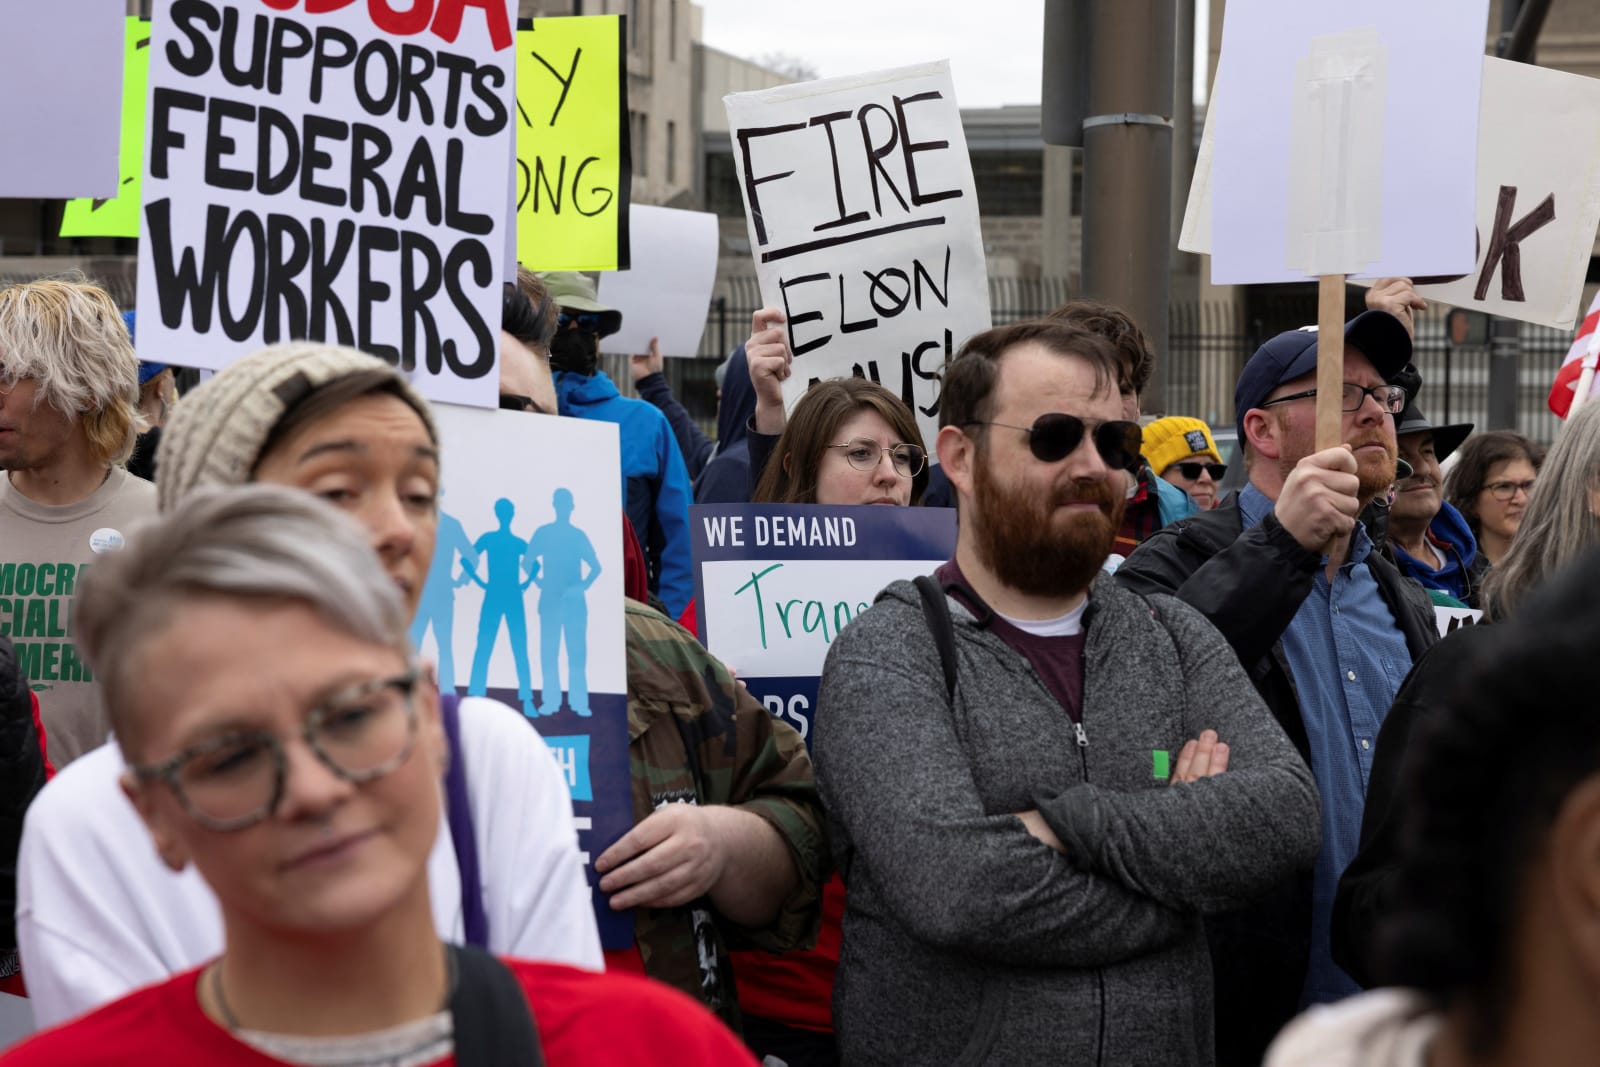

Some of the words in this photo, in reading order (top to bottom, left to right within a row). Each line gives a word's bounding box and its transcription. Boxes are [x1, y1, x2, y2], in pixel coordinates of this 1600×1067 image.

[165, 0, 508, 137] SUPPORTS
[150, 86, 494, 235] FEDERAL
[736, 90, 963, 246] FIRE
[144, 197, 496, 380] WORKERS
[779, 245, 952, 357] ELON
[0, 562, 91, 596] MOCR
[703, 515, 745, 547] WE
[754, 515, 857, 547] DEMAND
